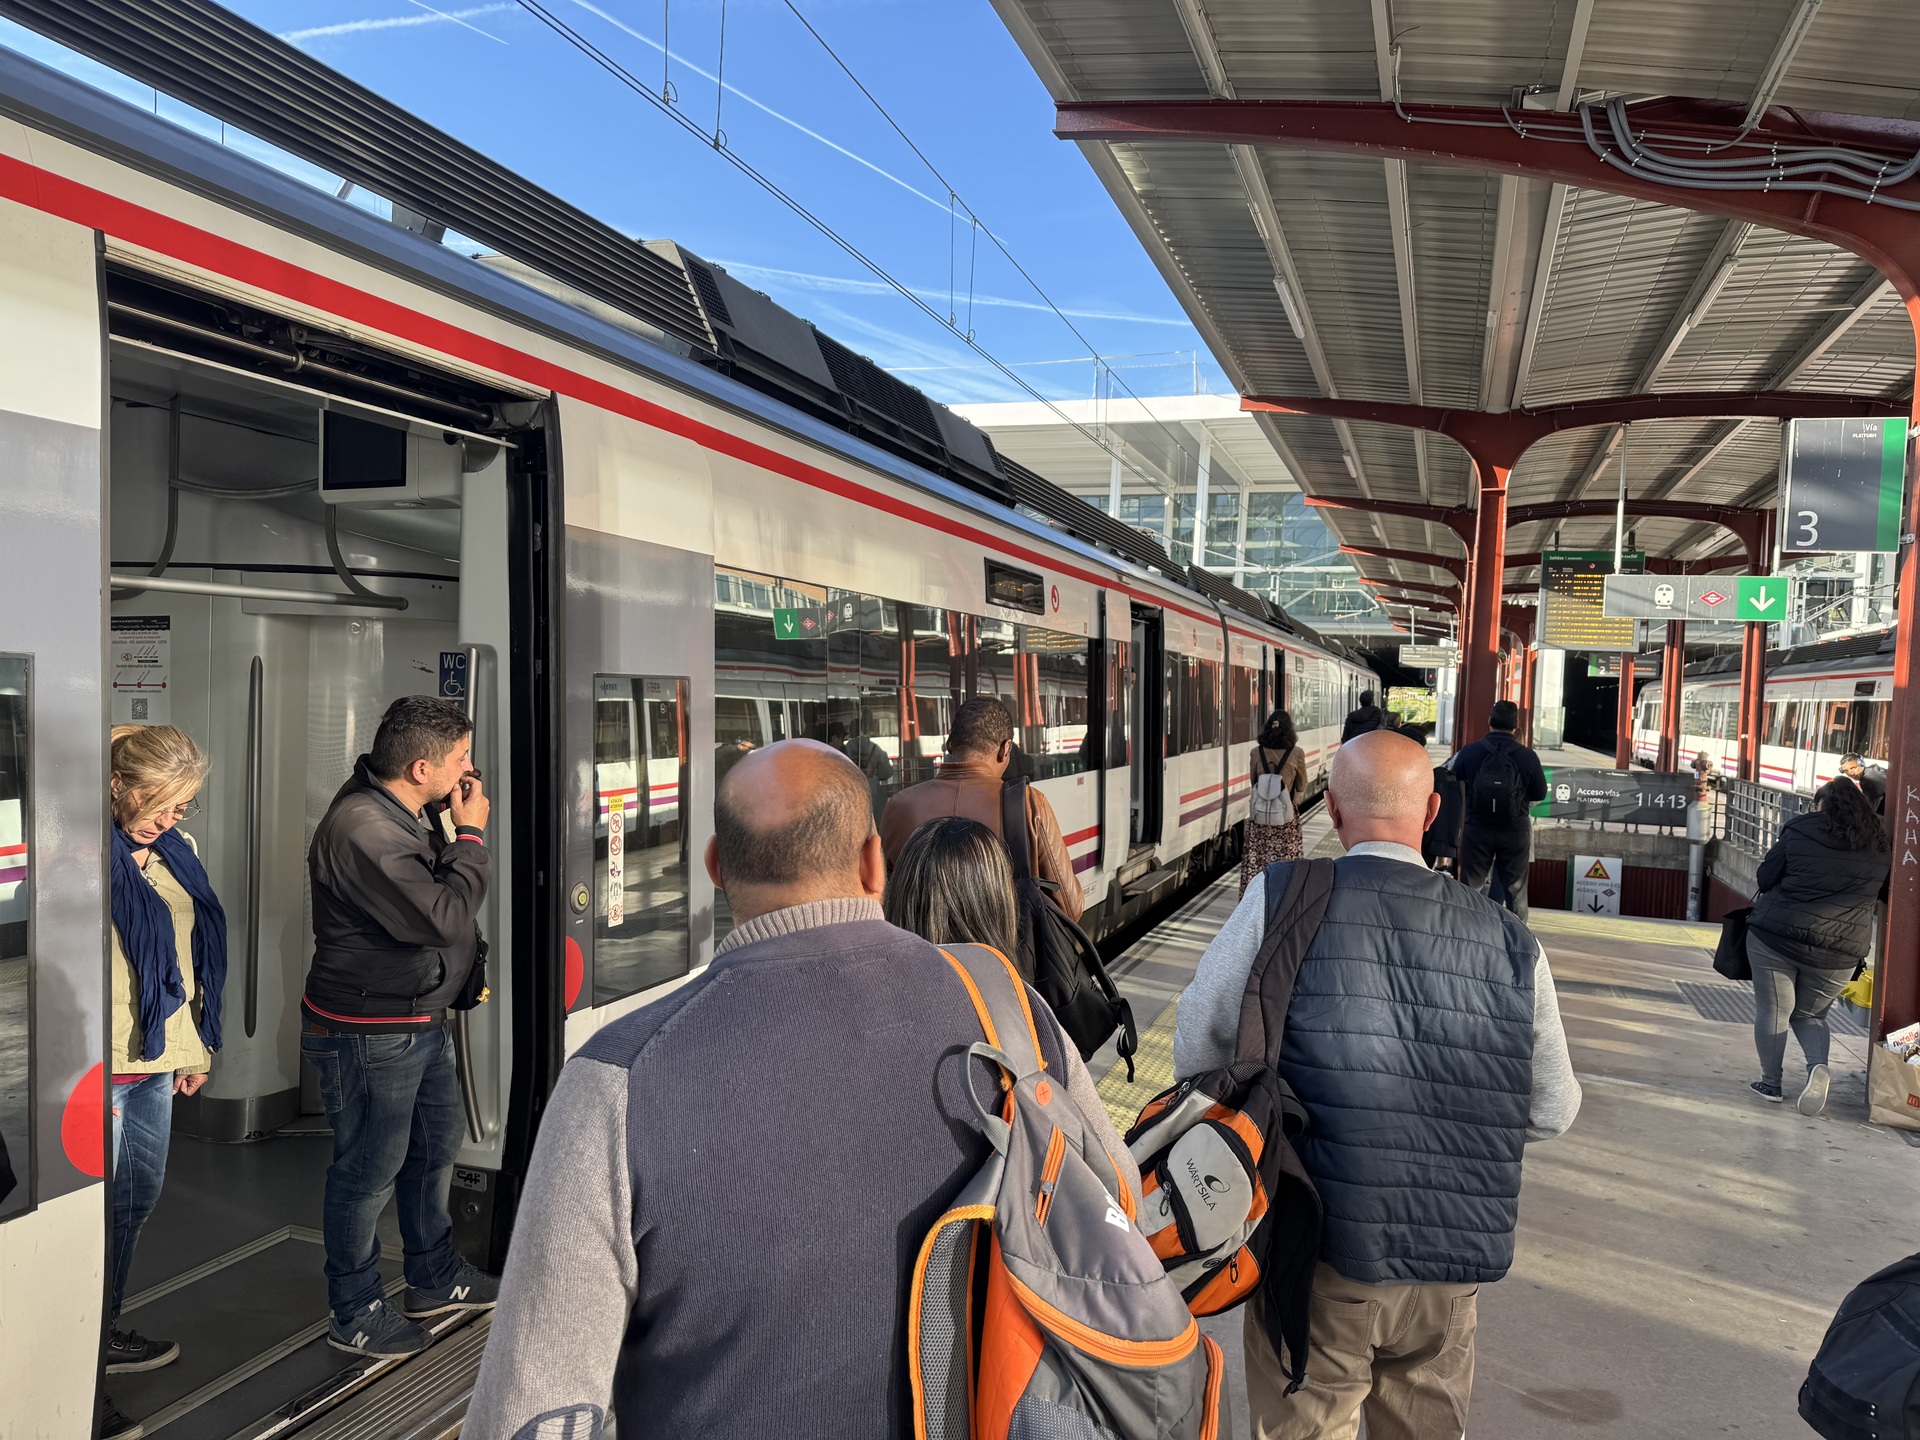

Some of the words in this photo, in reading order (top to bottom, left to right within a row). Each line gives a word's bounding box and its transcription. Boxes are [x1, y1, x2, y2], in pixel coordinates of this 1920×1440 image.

[1865, 423, 1877, 431] Vía
[1796, 510, 1818, 546] 3
[443, 654, 465, 669] WC
[1599, 666, 1606, 675] 2
[1577, 788, 1604, 796] Acceso
[1576, 796, 1610, 804] PLATFORMS
[1635, 792, 1643, 807] 1
[1892, 1031, 1919, 1048] nutella
